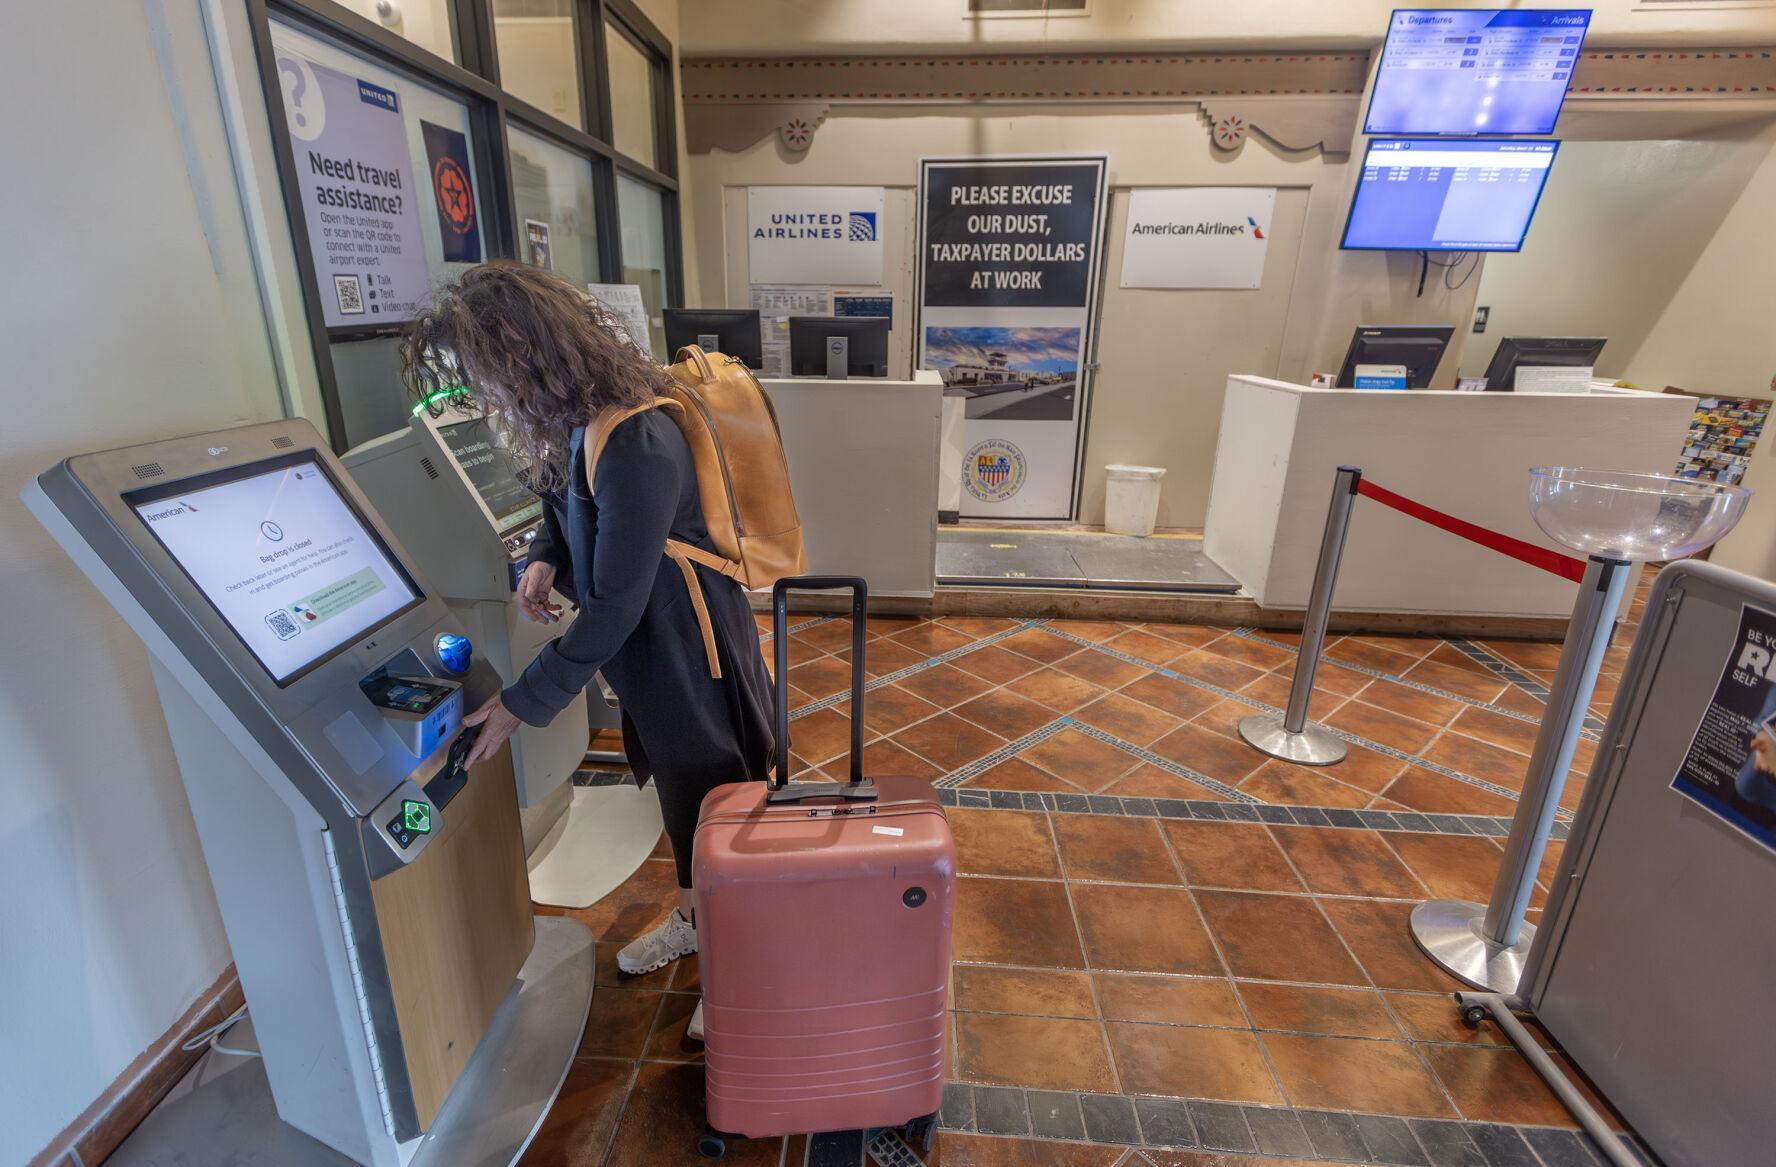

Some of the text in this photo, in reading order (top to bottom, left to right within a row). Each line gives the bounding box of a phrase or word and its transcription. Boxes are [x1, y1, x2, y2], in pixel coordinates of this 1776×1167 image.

[1408, 15, 1453, 25] Departures
[1551, 15, 1585, 25] Arrivals
[361, 87, 387, 102] UNITED
[308, 151, 402, 189] Need travel
[316, 185, 403, 216] assistance?
[951, 185, 1073, 205] PLEASE EXCUSE
[321, 212, 393, 230] Open the United app
[771, 214, 842, 225] UNITED
[967, 214, 1051, 236] OUR DUST,
[323, 227, 401, 242] or scan the QR code to
[754, 228, 842, 239] AIRLINES
[1132, 222, 1244, 235] American Airlines
[326, 241, 355, 252] connect
[357, 242, 373, 253] with
[380, 244, 401, 255] United
[931, 243, 1086, 262] TAXPAYER DOLLARS
[329, 255, 356, 267] airport
[376, 274, 391, 285] Talk
[970, 271, 1042, 289] AT WORK
[379, 289, 395, 298] Text
[381, 301, 401, 312] Video
[147, 506, 185, 523] American
[259, 553, 275, 565] Bag
[271, 547, 290, 560] drop
[292, 538, 312, 550] closed
[1747, 628, 1762, 643] BE
[1732, 668, 1758, 687] SELF
